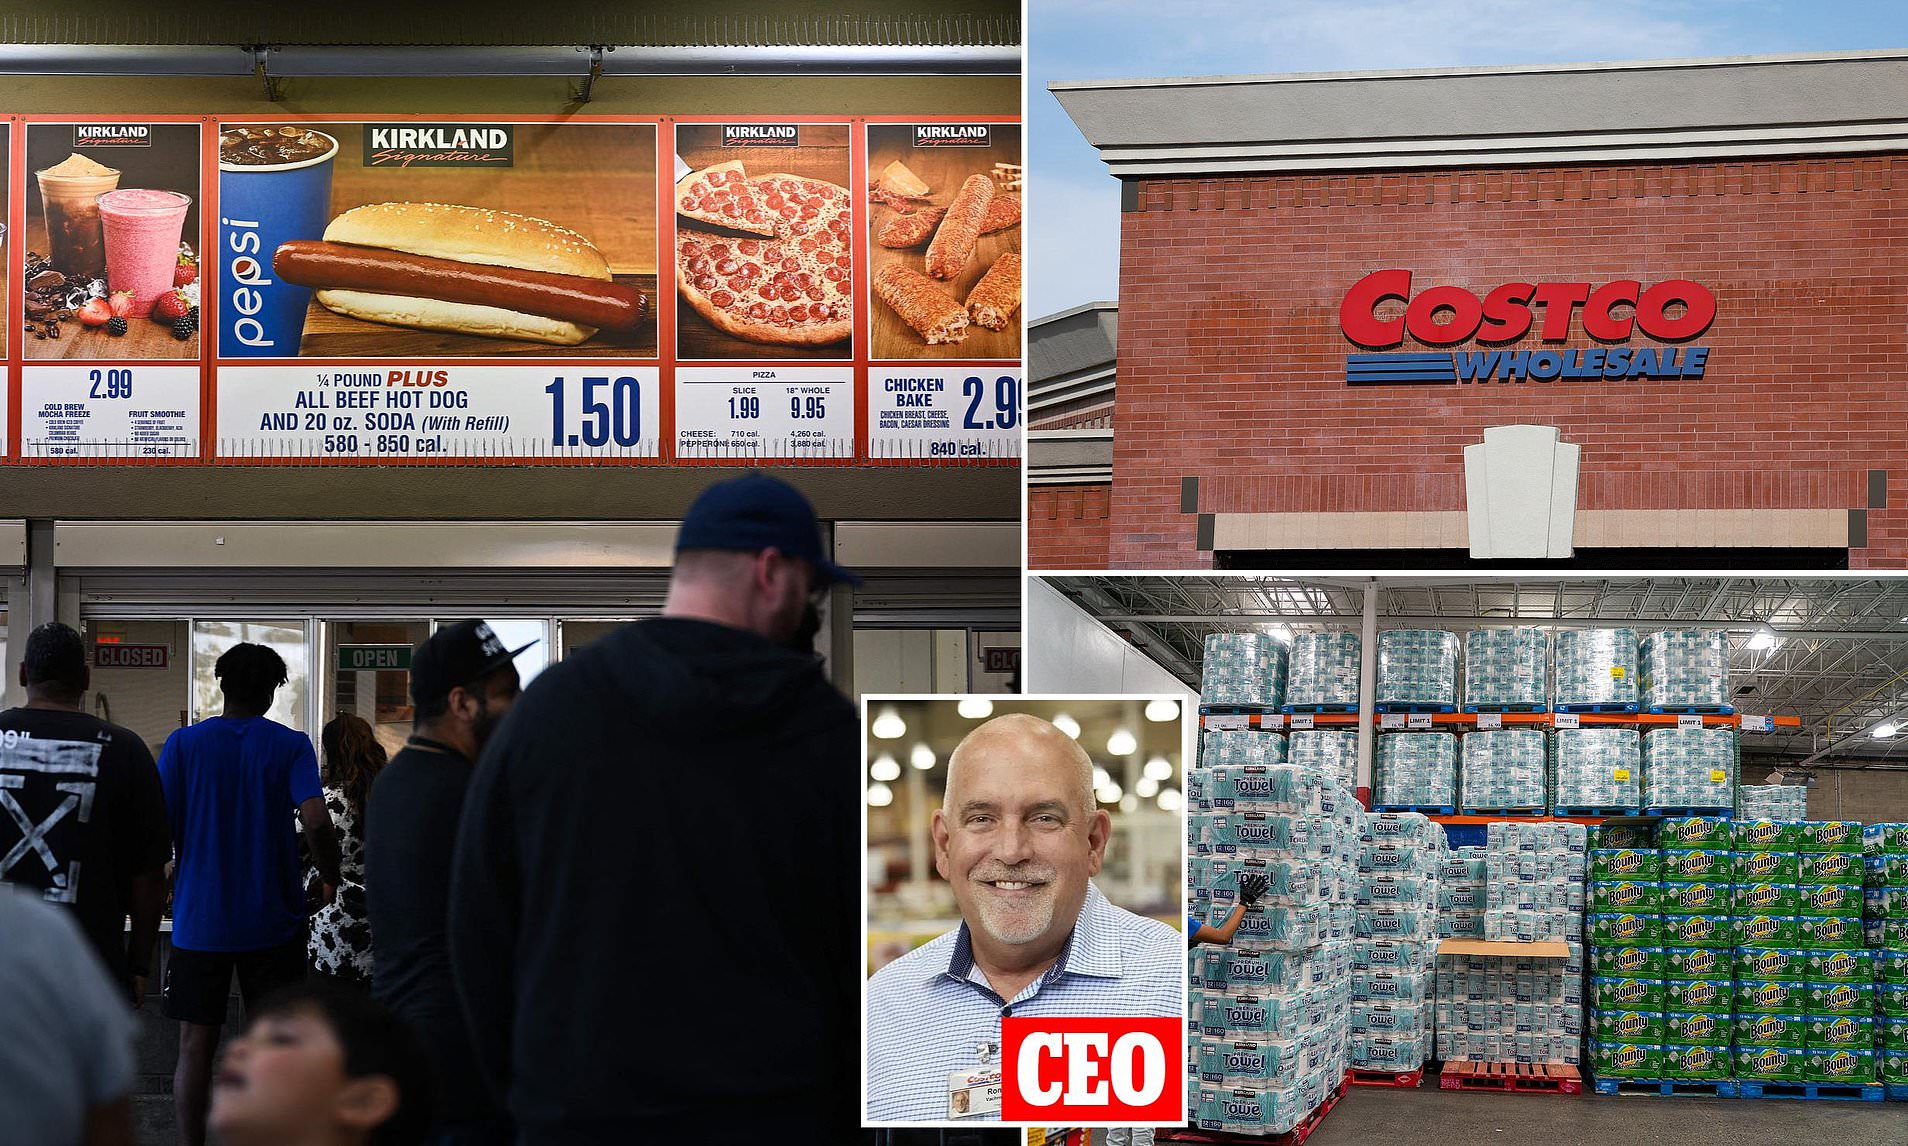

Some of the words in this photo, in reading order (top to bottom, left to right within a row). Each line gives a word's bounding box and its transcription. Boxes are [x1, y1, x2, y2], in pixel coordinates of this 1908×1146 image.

[78, 126, 148, 137] KIRKLAND
[371, 128, 508, 149] KIRKLAND
[726, 127, 796, 137] KIRKLAND
[917, 127, 987, 137] KIRKLAND
[77, 137, 148, 146] Signature
[726, 137, 796, 146] Signature
[917, 137, 987, 146] Signature
[371, 148, 508, 167] Signature
[222, 217, 274, 347] pepsi
[1340, 269, 1717, 347] COSTCO
[1456, 346, 1710, 385] WHOLESALE
[89, 369, 132, 398] 2.99
[334, 374, 382, 387] POUND
[386, 370, 448, 387] PLUS
[885, 378, 944, 392] CHICKEN
[295, 391, 329, 408] ALL
[335, 391, 380, 408] BEEF
[388, 391, 423, 408] HOT
[430, 391, 468, 409] DOG
[728, 397, 760, 419] 1.99
[791, 397, 825, 419] 9.95
[896, 394, 933, 407] BAKE
[963, 376, 1021, 430] 2.9
[545, 376, 641, 447] 1.50
[880, 411, 903, 419] CHICKEN
[260, 414, 298, 430] AND
[304, 413, 327, 430] 20
[333, 417, 358, 430] oz.
[365, 413, 415, 430] SODA
[421, 415, 460, 432] (With
[464, 415, 509, 432] Refill)
[901, 420, 922, 428] CAESAR
[923, 420, 950, 429] DRESSING
[746, 430, 760, 438] cal.
[812, 430, 826, 438] cal.
[325, 435, 358, 452] 580
[377, 435, 409, 452] 850
[415, 435, 447, 452] cal.
[931, 442, 956, 455] 840
[960, 442, 986, 455] cal.
[99, 648, 163, 666] CLOSED
[352, 649, 398, 666] OPEN
[1234, 778, 1275, 792] Towel
[1234, 825, 1275, 839] Towel
[1603, 829, 1635, 847] Bounty
[1678, 821, 1712, 840] Bounty
[1747, 823, 1782, 843] Bounty
[1816, 825, 1850, 843] Bounty
[1372, 853, 1400, 863] Towel
[1608, 853, 1643, 872] Bounty
[1680, 854, 1714, 873] Bounty
[1814, 855, 1849, 875] Bounty
[1444, 866, 1469, 875] Towel
[1370, 886, 1399, 896] Towel
[1450, 894, 1474, 903] Towel
[1609, 885, 1643, 905] Bounty
[1680, 887, 1715, 906] Bounty
[1746, 887, 1781, 906] Bounty
[1811, 889, 1846, 908] Bounty
[1239, 918, 1271, 930] owel
[1372, 919, 1400, 929] Towel
[1450, 921, 1475, 929] Towel
[1610, 918, 1645, 937] Bounty
[1680, 920, 1715, 939] Bounty
[1744, 919, 1779, 939] Bounty
[1368, 950, 1398, 960] Towel
[1614, 951, 1648, 969] Bounty
[1683, 953, 1716, 973] Bounty
[1227, 961, 1269, 976] Towel
[1753, 954, 1788, 975] Bounty
[1822, 955, 1857, 975] Bounty
[1368, 982, 1398, 992] Towel
[1614, 984, 1647, 1002] Bounty
[1682, 985, 1716, 1004] Bounty
[1754, 987, 1788, 1007] Bounty
[1824, 989, 1859, 1010] Bounty
[1225, 1007, 1265, 1022] Towel
[1366, 1013, 1396, 1025] Towel
[1614, 1016, 1648, 1035] Bounty
[1681, 1018, 1715, 1037] Bounty
[1751, 1020, 1786, 1039] Bounty
[1825, 1022, 1859, 1041] Bounty
[1223, 1053, 1265, 1068] Towel
[1367, 1046, 1397, 1057] Towel
[1612, 1049, 1646, 1067] Bounty
[1680, 1050, 1713, 1070] Bounty
[1752, 1054, 1787, 1072] Bounty
[1823, 1056, 1858, 1075] Bounty
[1222, 1101, 1262, 1116] Towe
